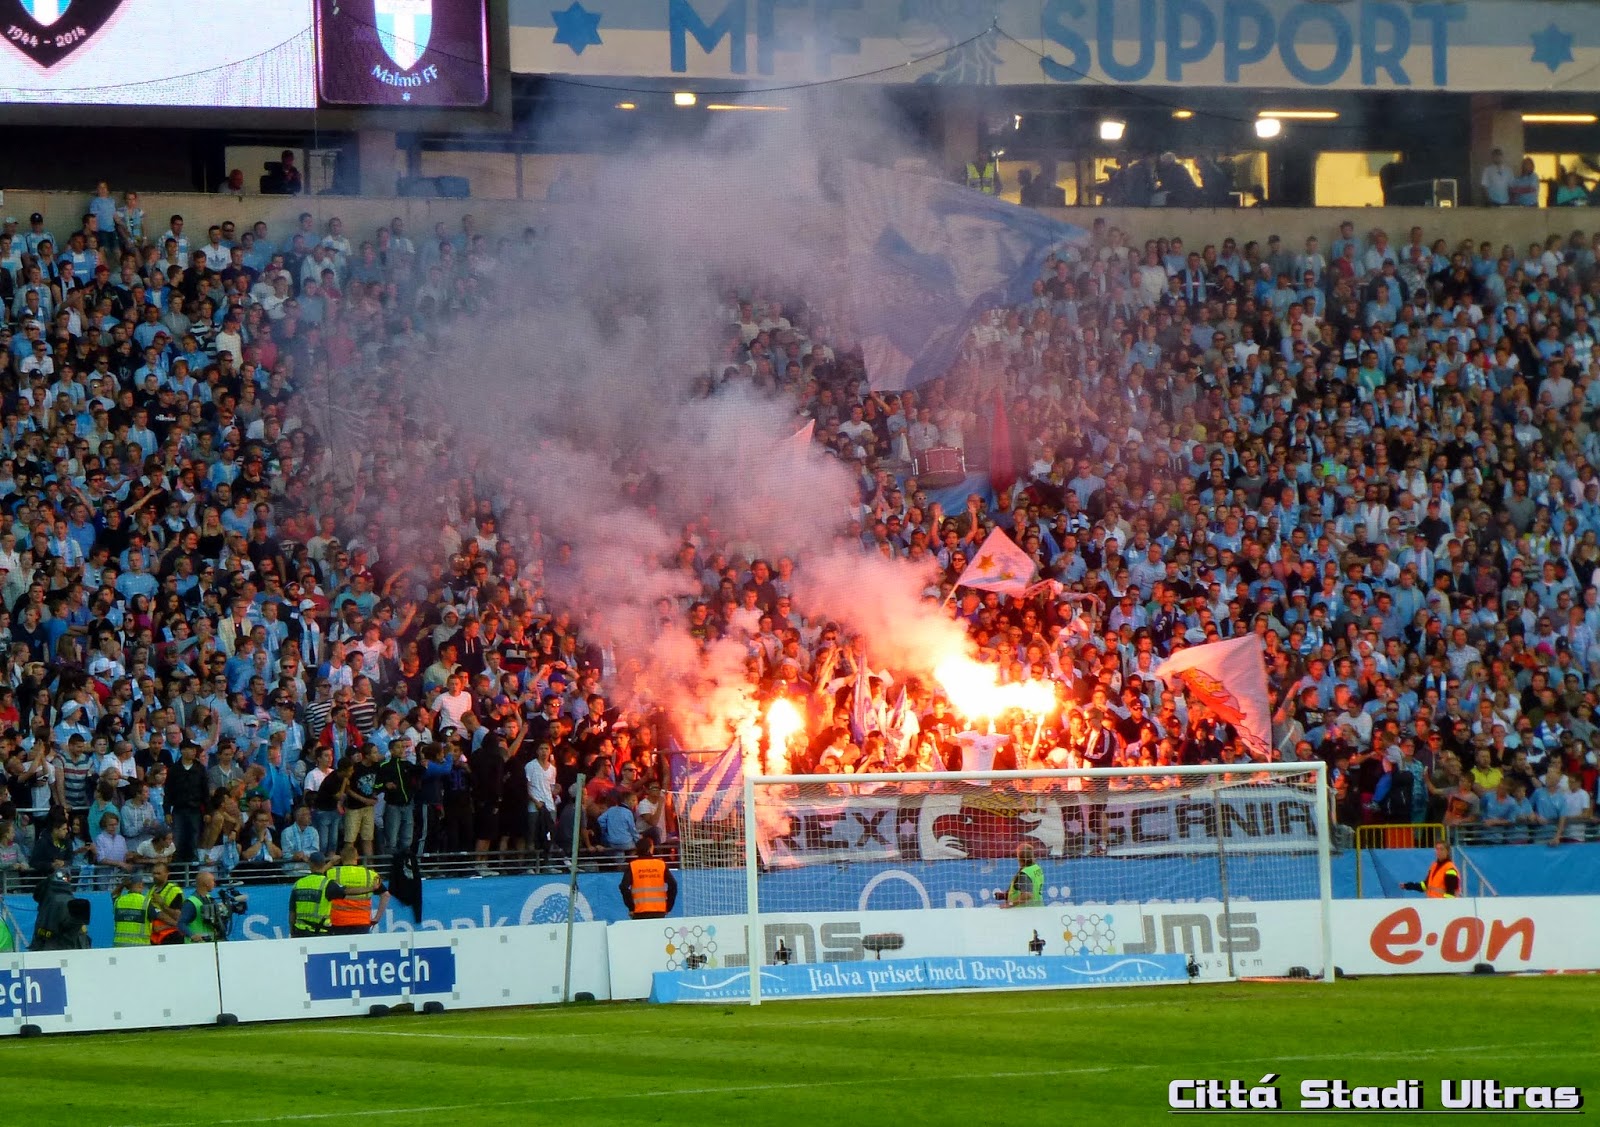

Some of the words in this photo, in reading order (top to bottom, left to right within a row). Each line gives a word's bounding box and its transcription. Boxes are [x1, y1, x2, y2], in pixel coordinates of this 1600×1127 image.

[7, 25, 39, 47] 1944
[55, 26, 87, 48] 2014
[669, 0, 862, 76] MFF
[1039, 0, 1468, 86] SUPPORT
[371, 64, 421, 87] Malmö
[422, 63, 438, 83] FF
[1088, 800, 1318, 845] SCANIA
[330, 955, 430, 987] Imtech
[808, 965, 864, 992] Halva
[867, 964, 926, 992] priset
[928, 959, 967, 984] med
[971, 959, 1048, 984] BroPass
